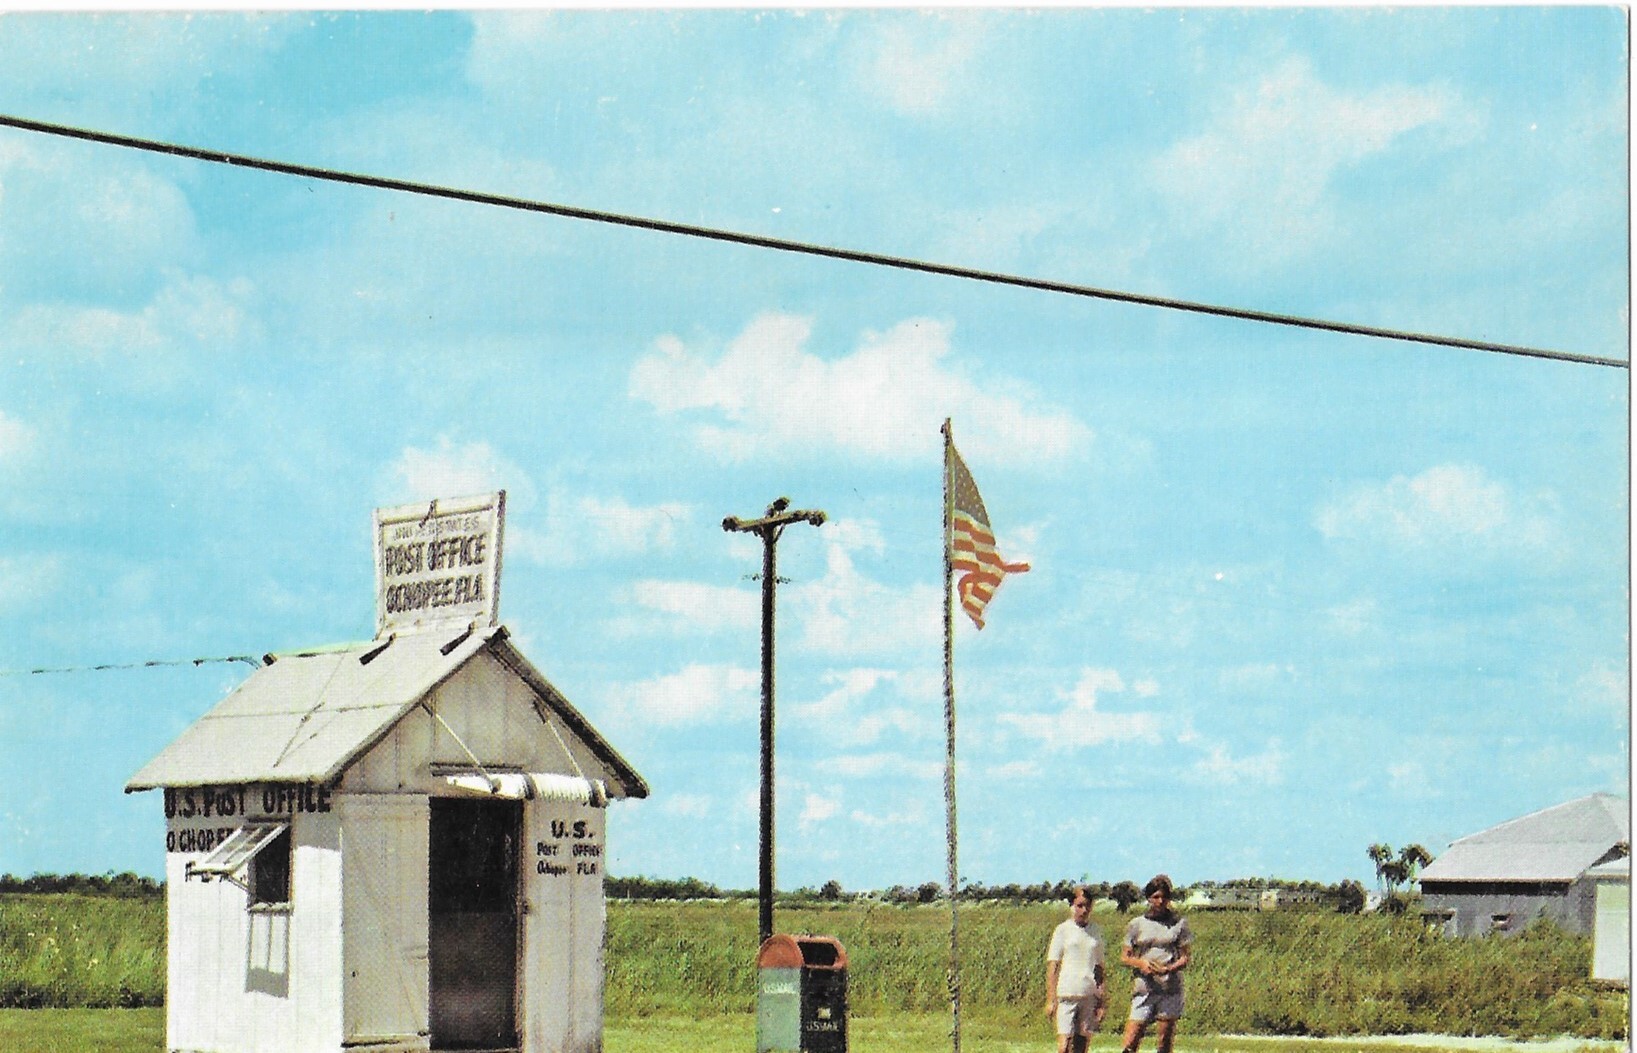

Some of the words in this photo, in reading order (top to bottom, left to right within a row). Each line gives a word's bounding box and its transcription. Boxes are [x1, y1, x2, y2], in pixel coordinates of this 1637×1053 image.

[385, 541, 425, 577] POST
[427, 532, 486, 571] OFFICE
[262, 780, 331, 814] OFFICE
[551, 820, 594, 839] U.S.
